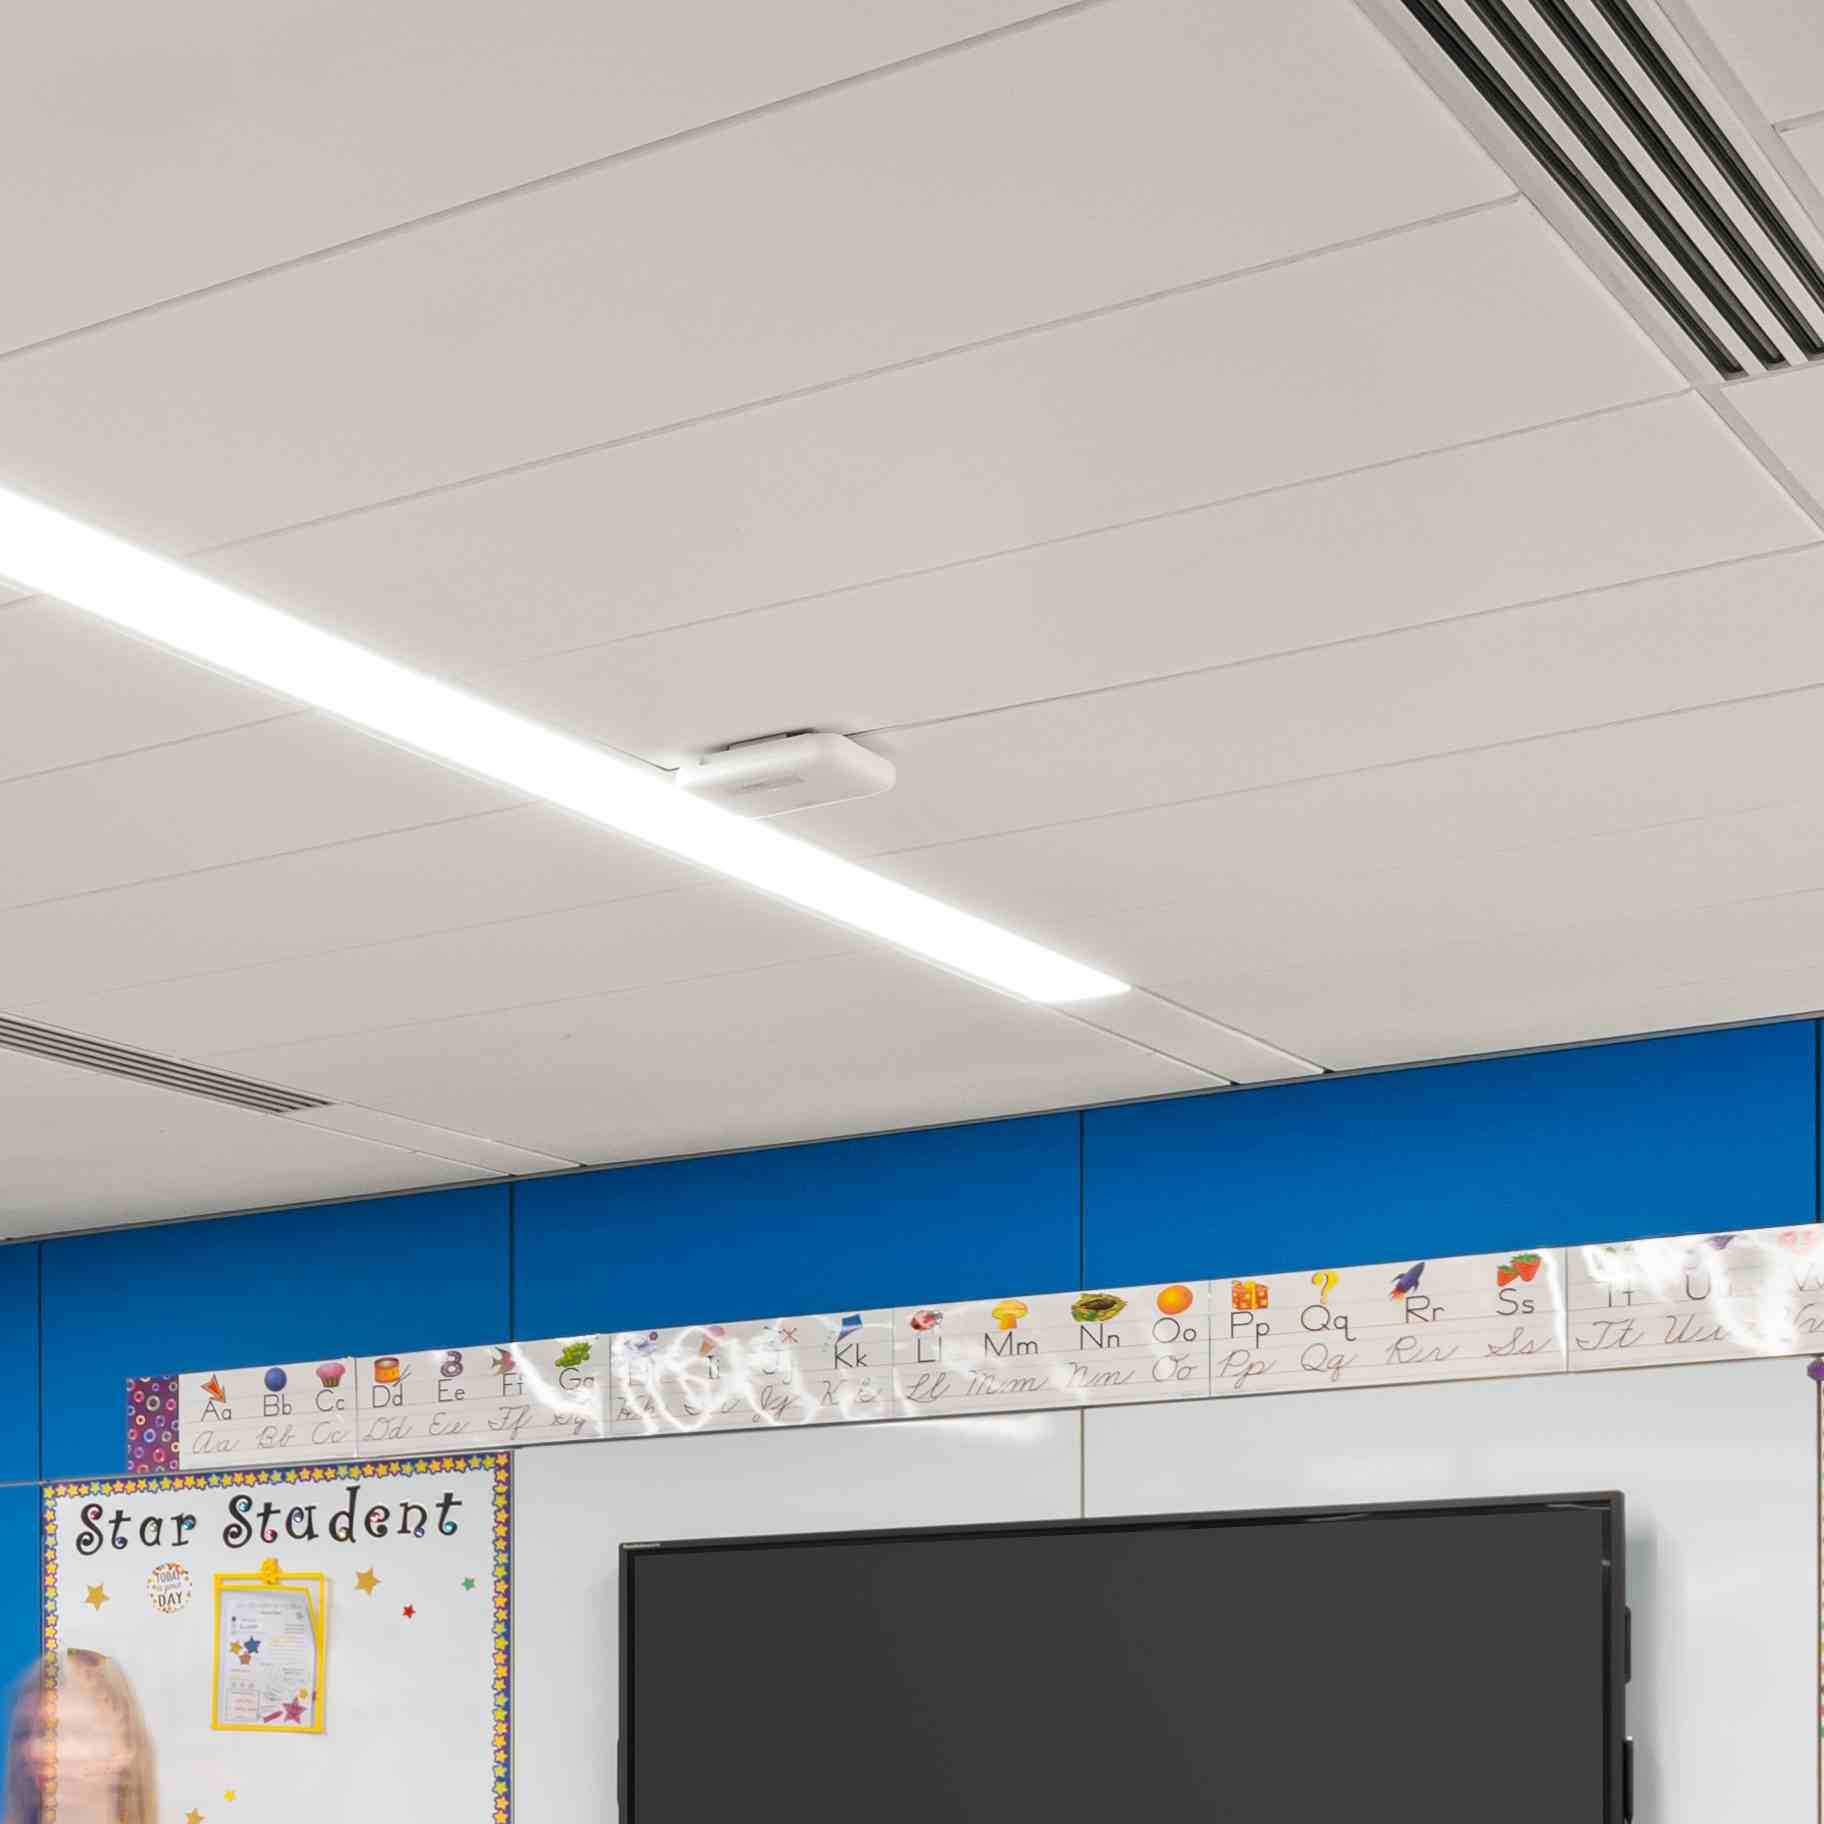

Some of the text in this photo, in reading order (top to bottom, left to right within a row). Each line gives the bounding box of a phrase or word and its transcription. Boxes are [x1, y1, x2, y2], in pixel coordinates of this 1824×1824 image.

[201, 1399, 232, 1423] Aa
[263, 1393, 293, 1417] Bb
[315, 1389, 345, 1412] Cc
[371, 1382, 403, 1408] Dd
[437, 1378, 466, 1402] Ee
[835, 1342, 868, 1369] Kk
[984, 1331, 1039, 1357] Mm
[1081, 1323, 1121, 1350] Nn
[1153, 1317, 1197, 1344] Oo
[1231, 1311, 1270, 1350] Pp
[1301, 1304, 1357, 1343] Qq
[1405, 1295, 1445, 1324] Rr
[1495, 1287, 1535, 1316] Ss
[74, 1484, 464, 1558] Star Student
[156, 1570, 181, 1584] TODAY
[157, 1591, 184, 1607] DAY
